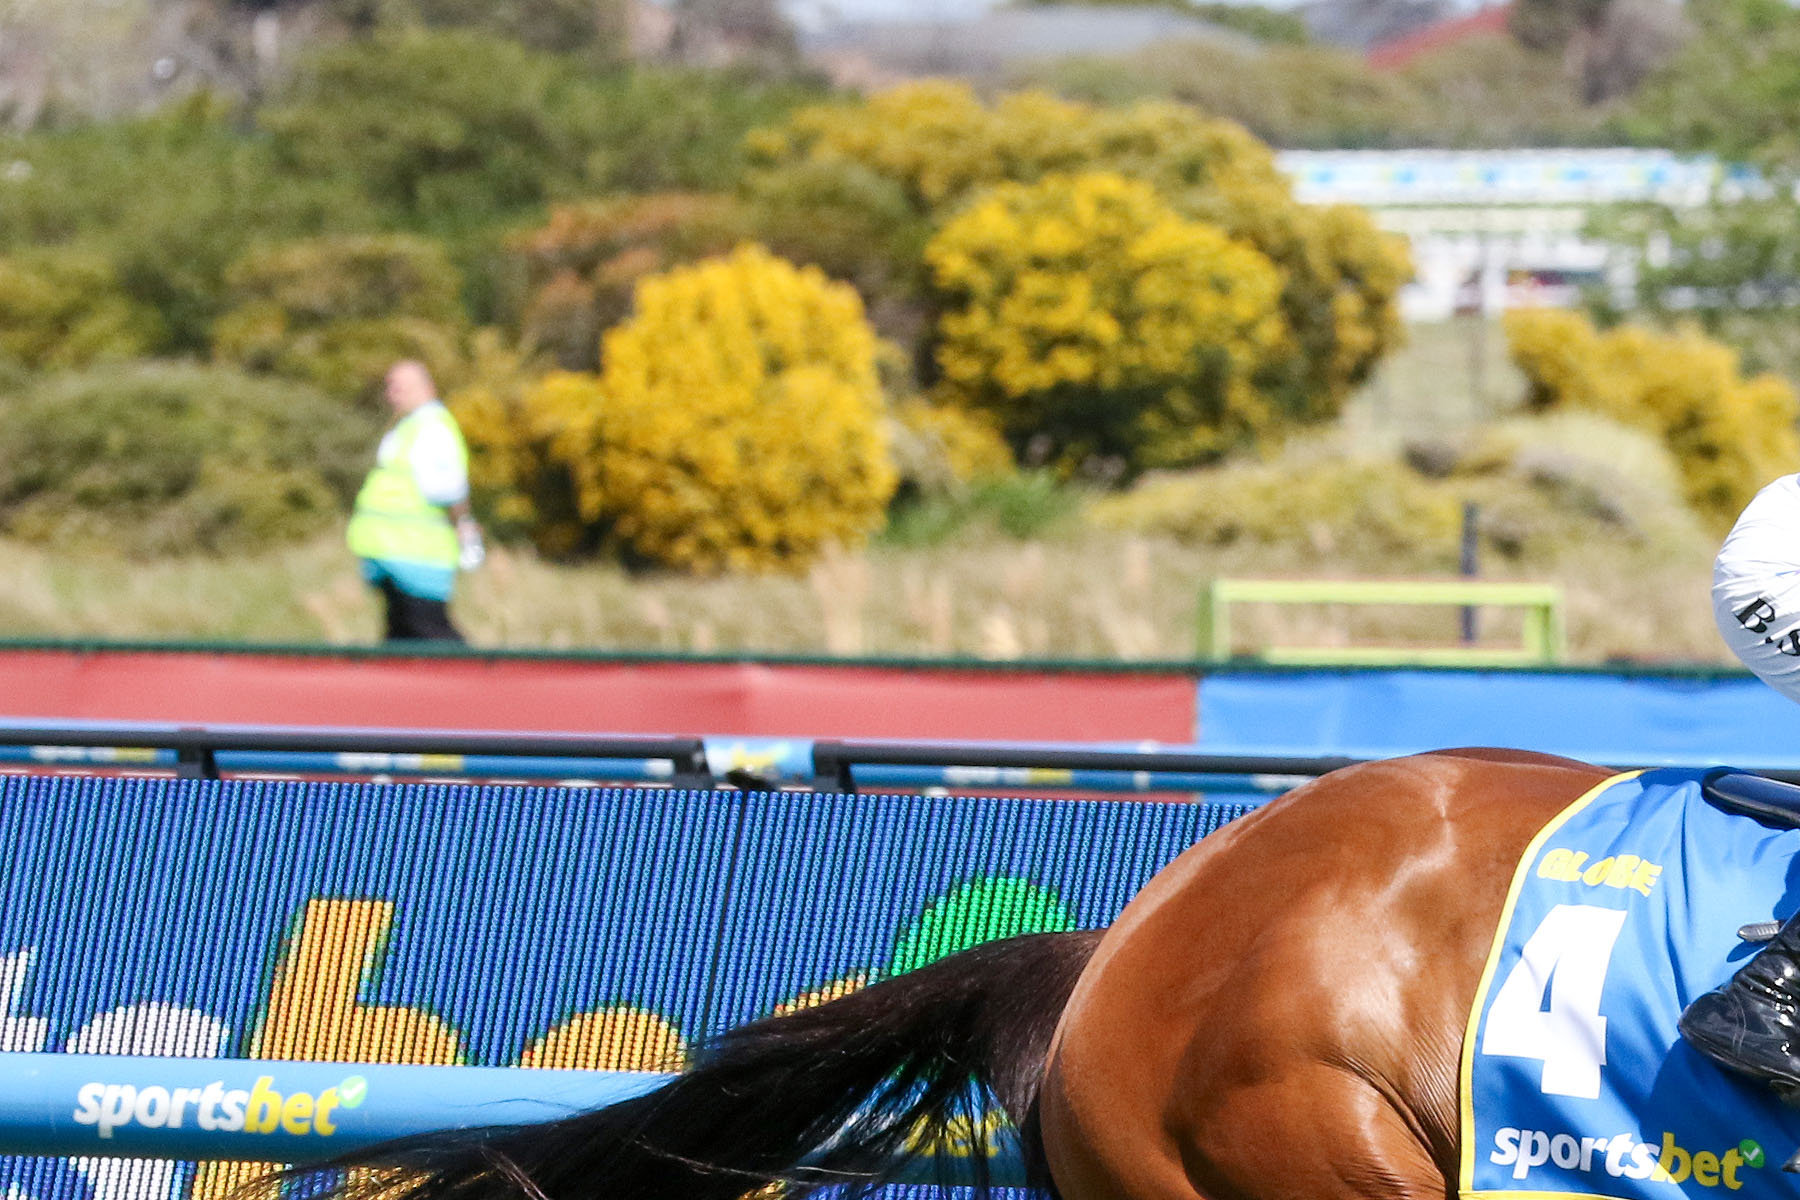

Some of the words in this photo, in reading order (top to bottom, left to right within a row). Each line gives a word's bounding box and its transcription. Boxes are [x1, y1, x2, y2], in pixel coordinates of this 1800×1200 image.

[1536, 848, 1662, 897] GLOBE
[1482, 903, 1628, 1100] 4
[73, 1075, 341, 1139] sportsbet
[1489, 1126, 1745, 1190] sportsbet
